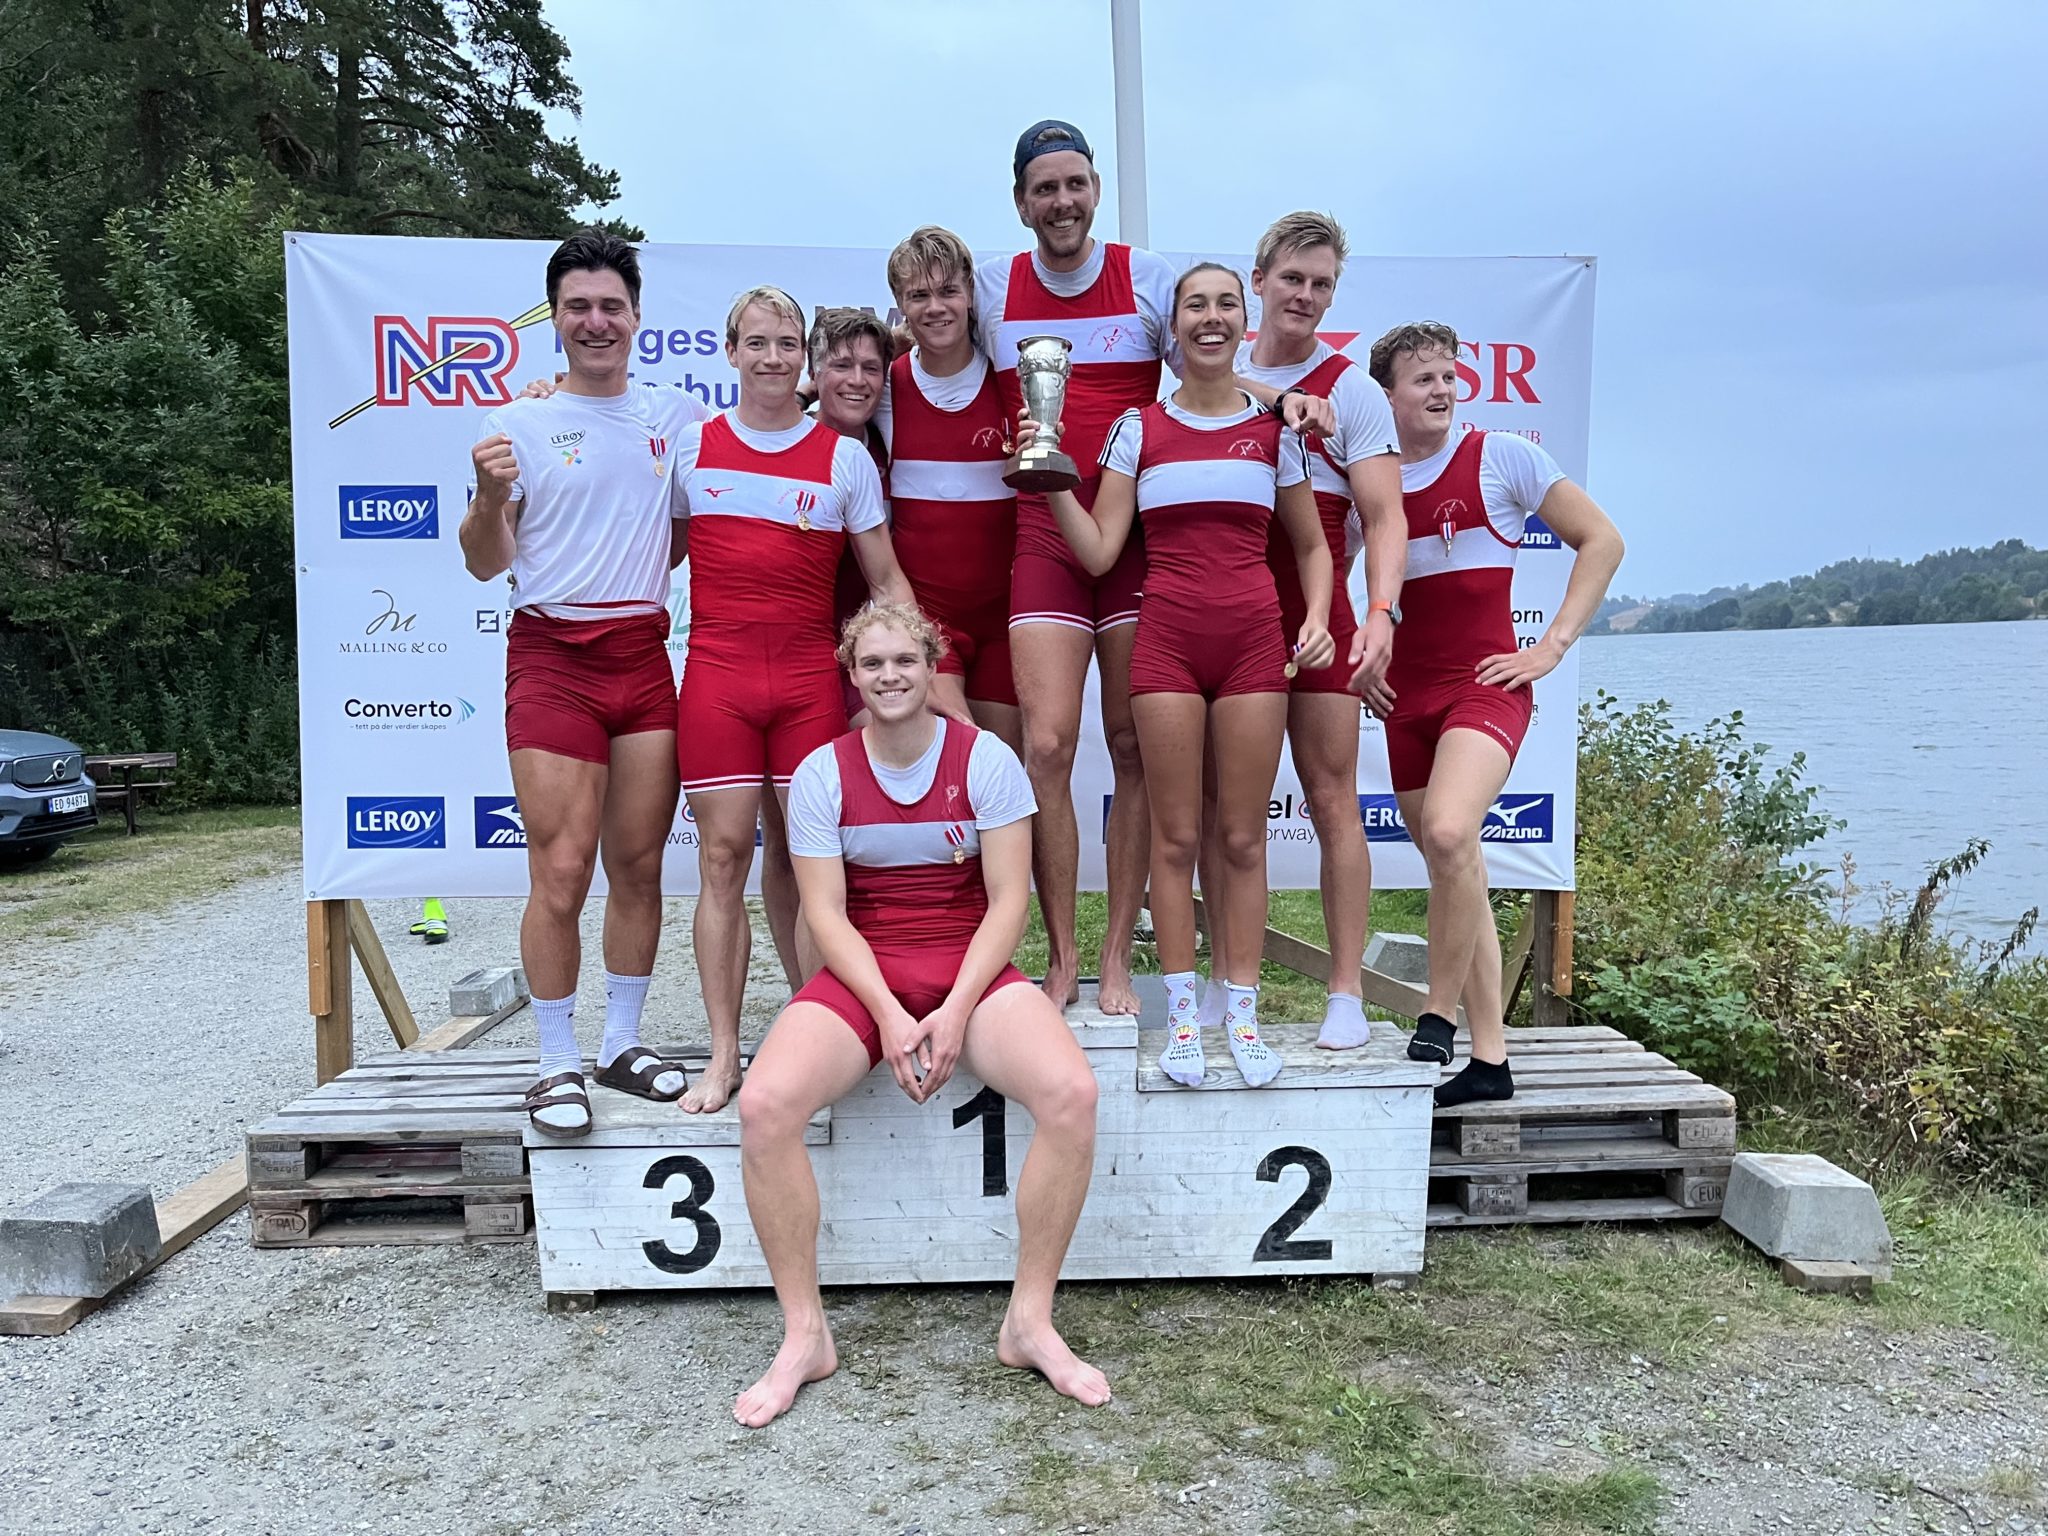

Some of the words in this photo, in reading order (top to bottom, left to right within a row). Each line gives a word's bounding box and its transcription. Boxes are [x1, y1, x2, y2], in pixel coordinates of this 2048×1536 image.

[348, 500, 428, 521] LERØY
[339, 643, 406, 653] MALLING
[428, 643, 447, 653] CO
[345, 699, 452, 717] Converto
[356, 811, 436, 831] LERØY
[952, 1085, 1006, 1197] 1
[1254, 1146, 1333, 1261] 2
[642, 1155, 721, 1275] 3
